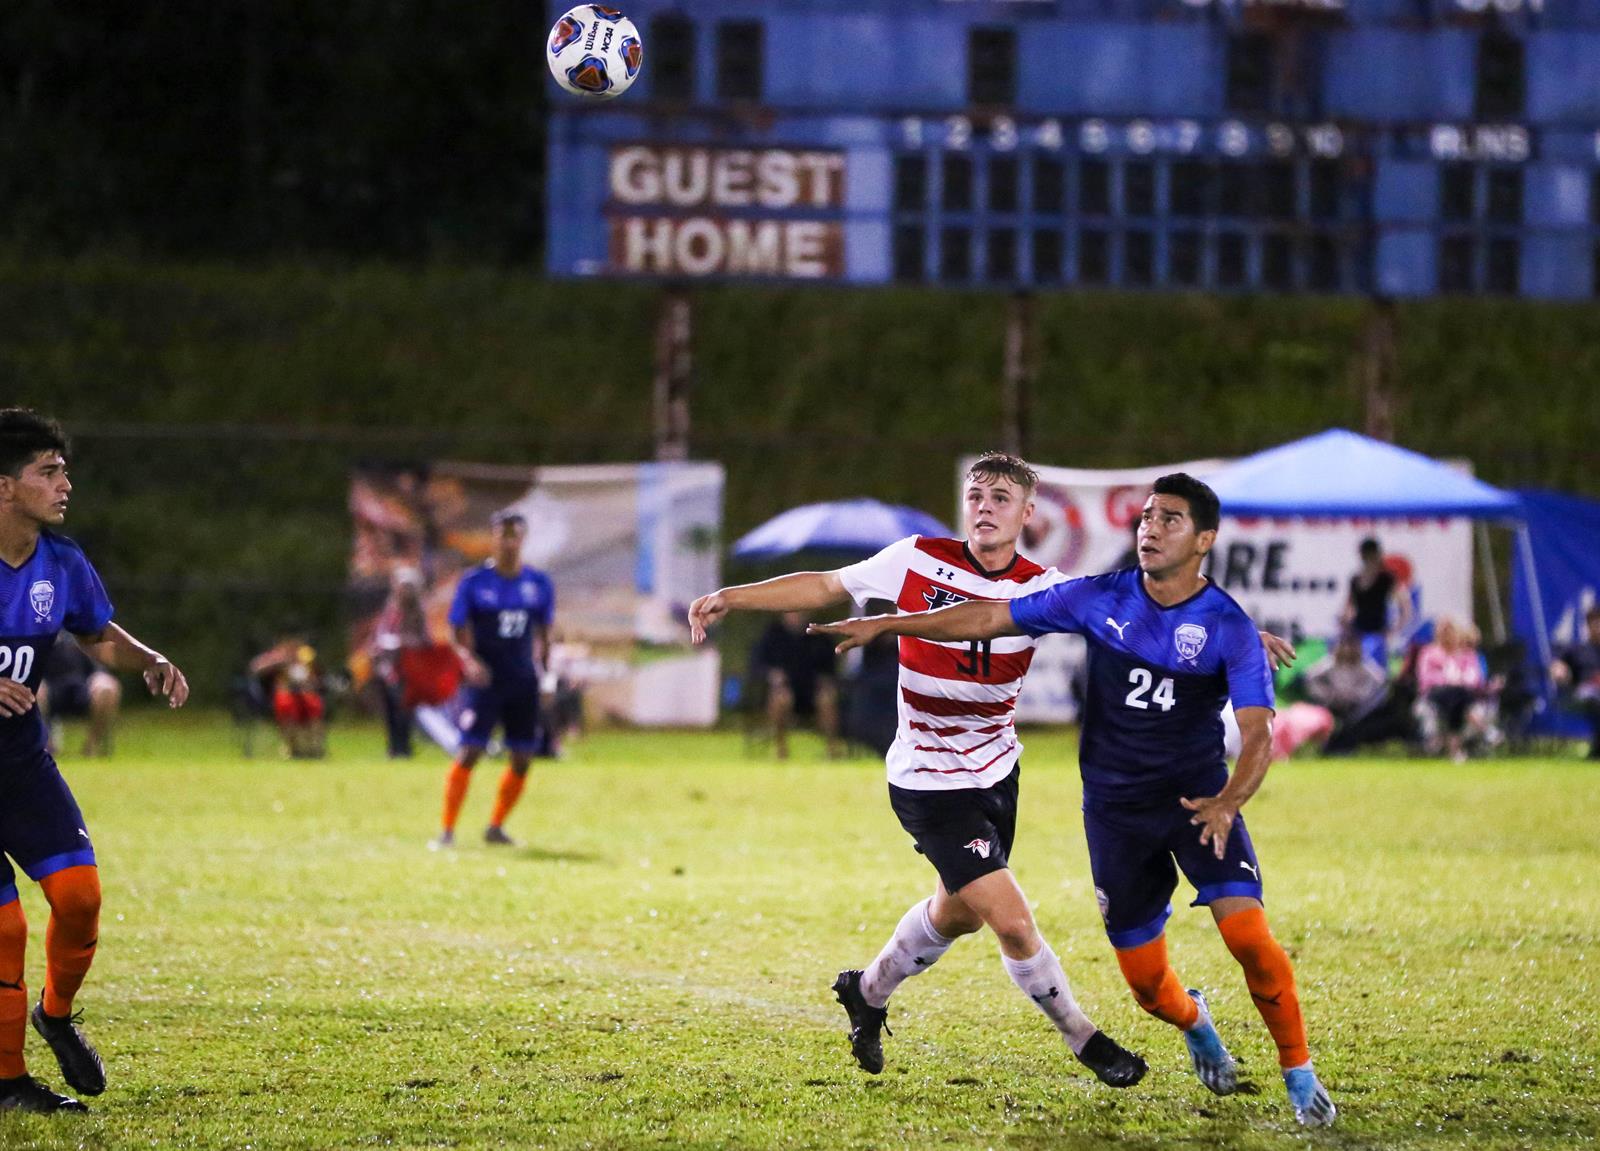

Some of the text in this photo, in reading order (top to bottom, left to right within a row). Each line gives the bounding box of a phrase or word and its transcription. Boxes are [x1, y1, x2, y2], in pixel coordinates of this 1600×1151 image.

[584, 21, 600, 51] Wilson
[601, 27, 614, 53] NCAA
[904, 115, 923, 149] 1
[946, 115, 972, 150] 2
[991, 115, 1018, 151] 3
[1035, 118, 1063, 150] 4
[1080, 118, 1108, 153] 5
[1127, 119, 1155, 154] 6
[1176, 120, 1199, 154] 7
[1219, 120, 1248, 156] 8
[610, 147, 844, 207] GUEST
[625, 217, 827, 278] HOME
[1125, 667, 1176, 712] 24
